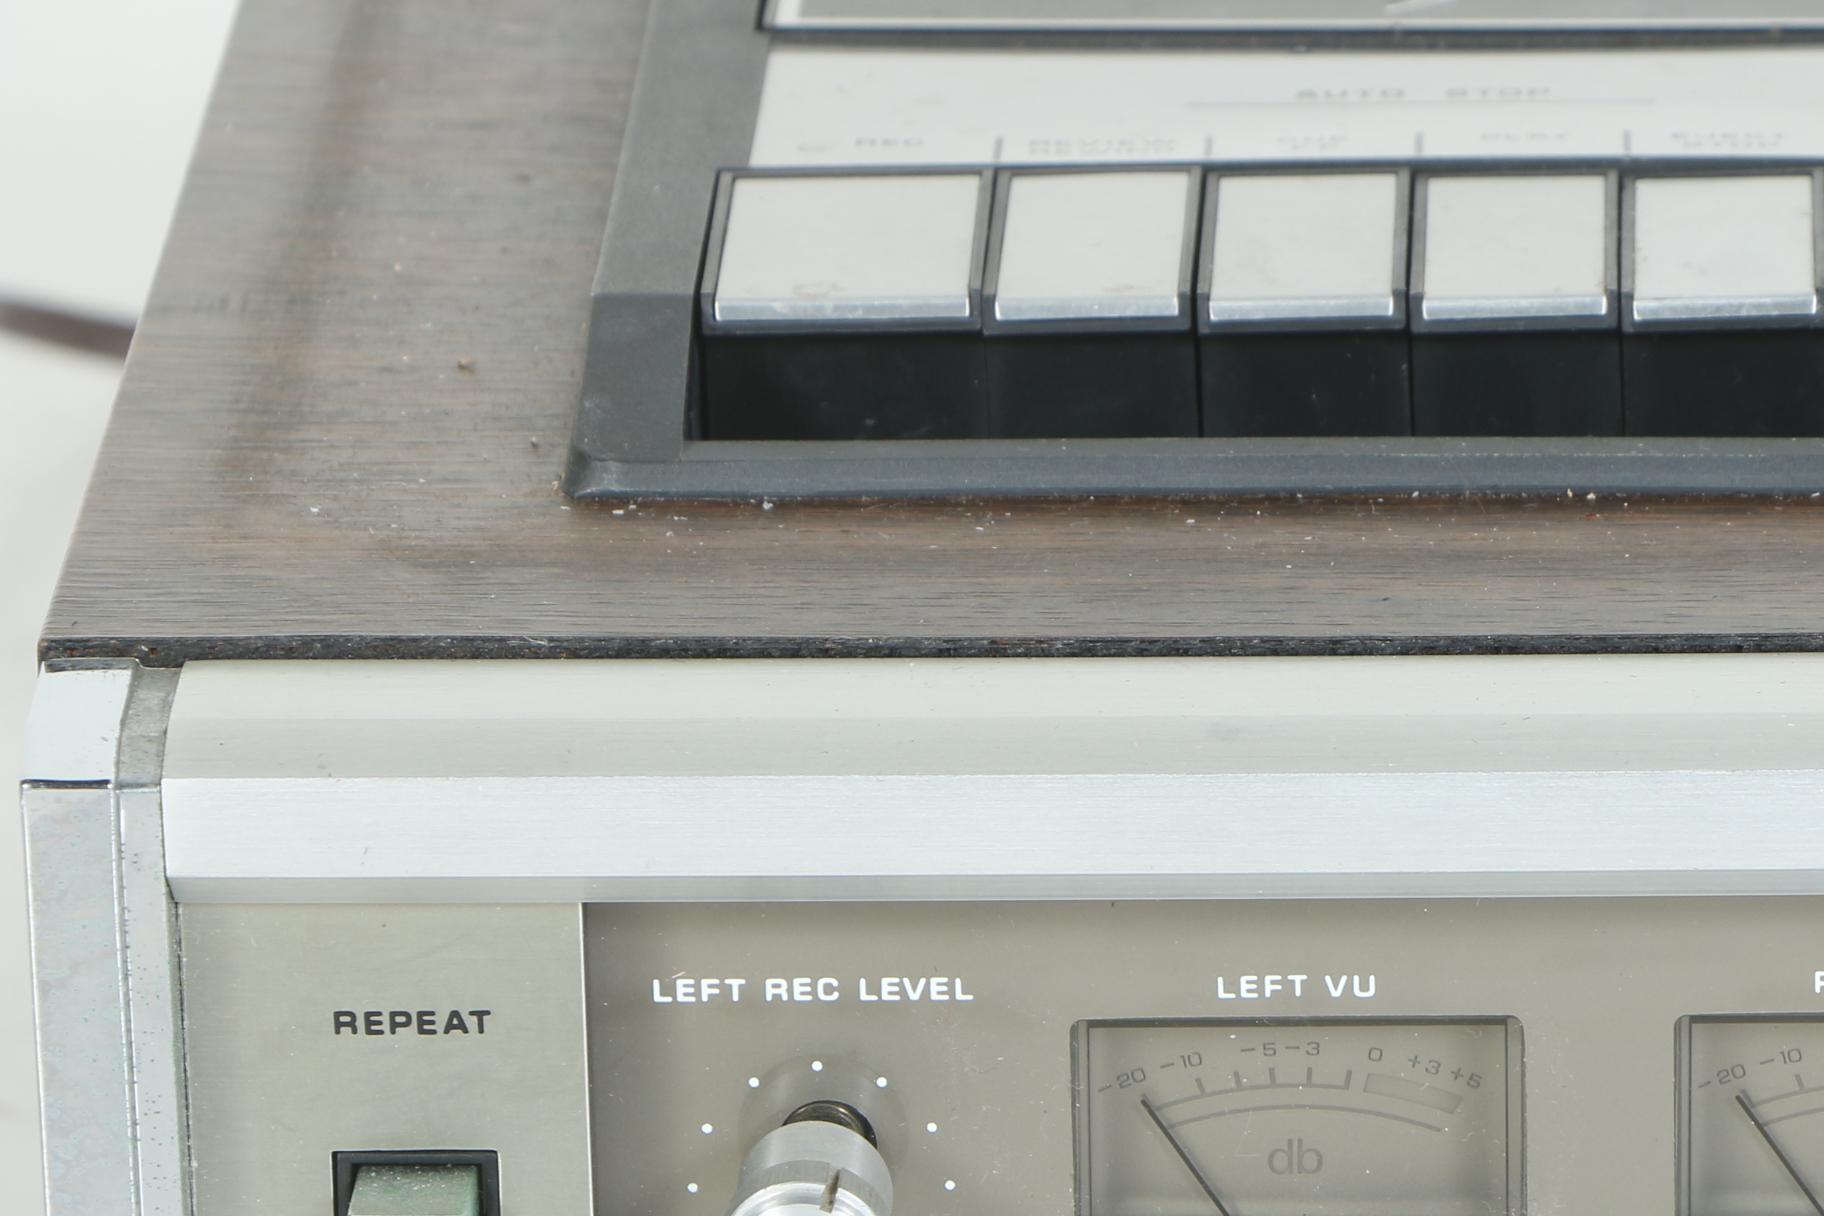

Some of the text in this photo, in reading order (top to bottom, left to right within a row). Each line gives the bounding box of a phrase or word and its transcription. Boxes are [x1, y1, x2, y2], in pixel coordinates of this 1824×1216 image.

[651, 976, 974, 1003] LEFT REC LEVEL
[1217, 974, 1376, 999] LEFT VU
[333, 1009, 492, 1036] REPEAT
[1367, 1047, 1383, 1063] 0
[1267, 1138, 1323, 1176] db
